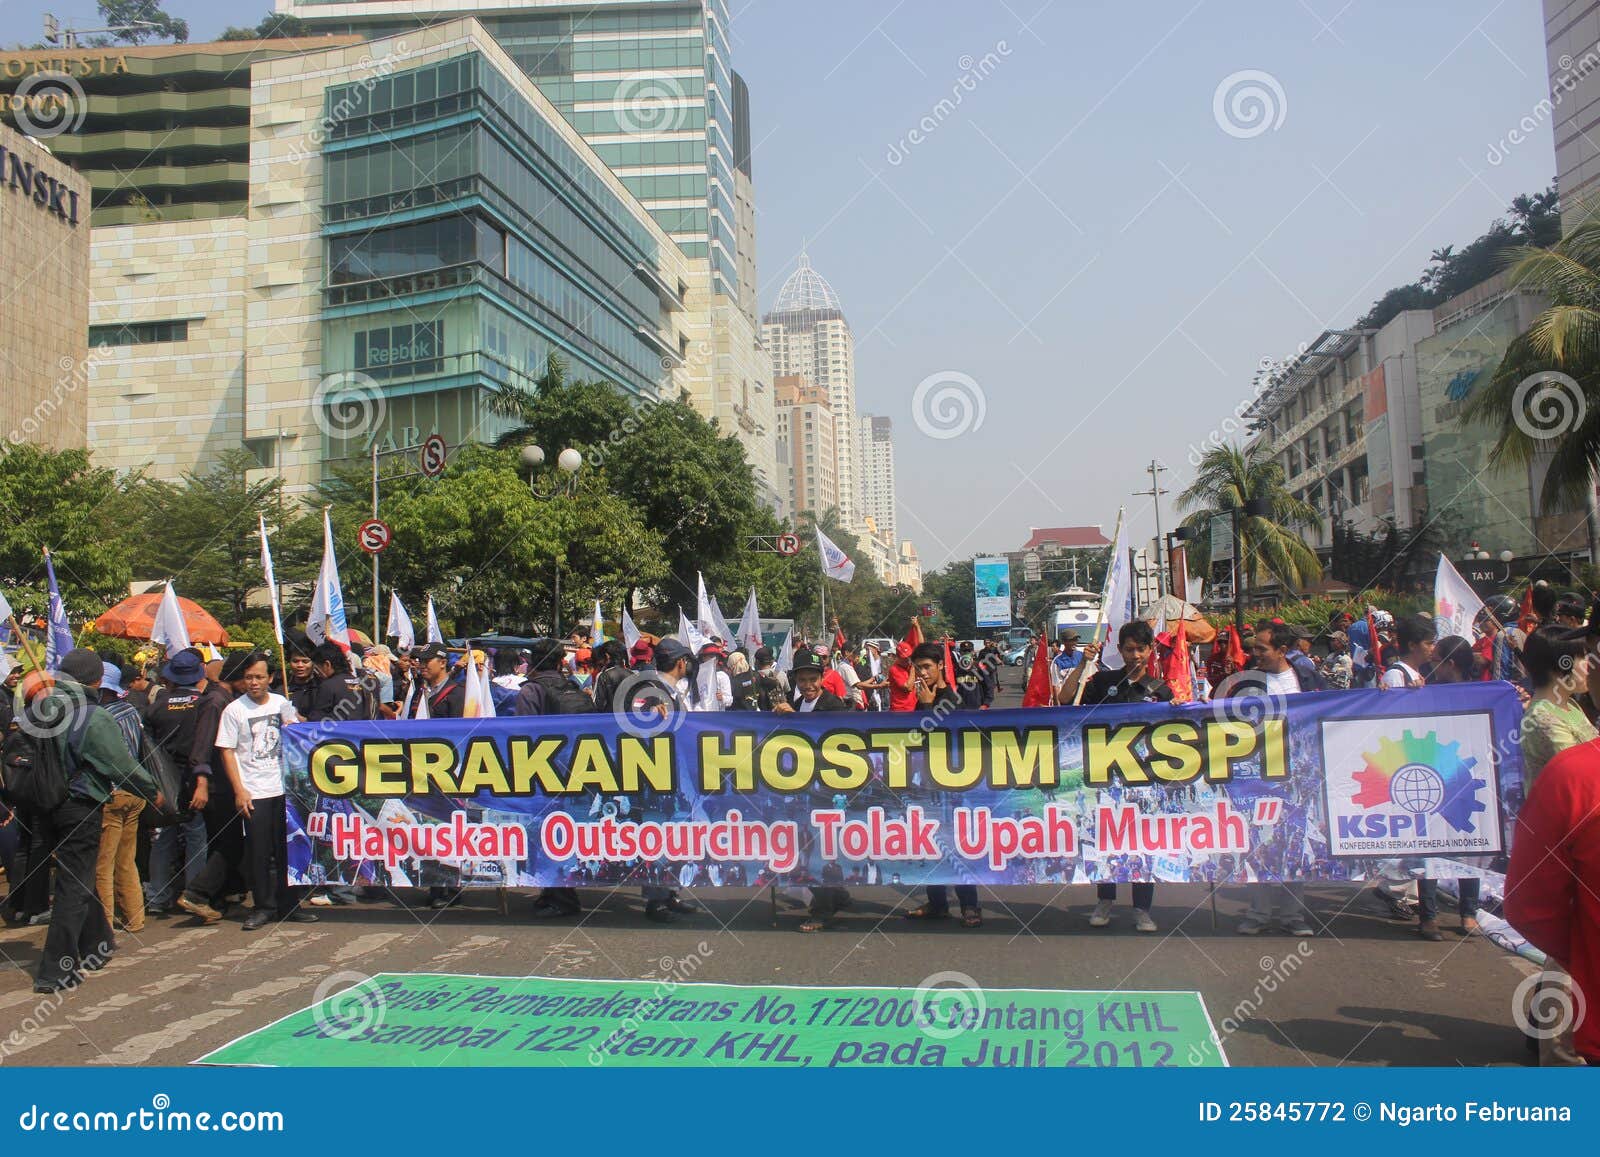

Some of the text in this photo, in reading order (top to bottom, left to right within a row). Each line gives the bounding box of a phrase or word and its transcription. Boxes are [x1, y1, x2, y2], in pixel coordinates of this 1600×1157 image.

[368, 340, 431, 363] Reebok
[1471, 571, 1495, 581] TAXI
[310, 719, 1287, 796] GERAKAN HOSTUM KSPI
[543, 811, 797, 869] Outsourcing
[814, 808, 939, 857] Tolak
[956, 806, 1075, 867] Upah
[1337, 813, 1427, 839] KSPI
[1339, 837, 1490, 850] KONFEDERASI SERIKAT PEKERJA INDONESIA
[947, 1001, 1085, 1040] tentang
[1097, 1001, 1179, 1033] KHL
[348, 1023, 521, 1052] sampai
[513, 1024, 600, 1052] 122
[703, 1030, 814, 1066] KHL,
[828, 1037, 947, 1067] pada
[960, 1038, 1048, 1067] Juli
[1064, 1040, 1179, 1067] 2012
